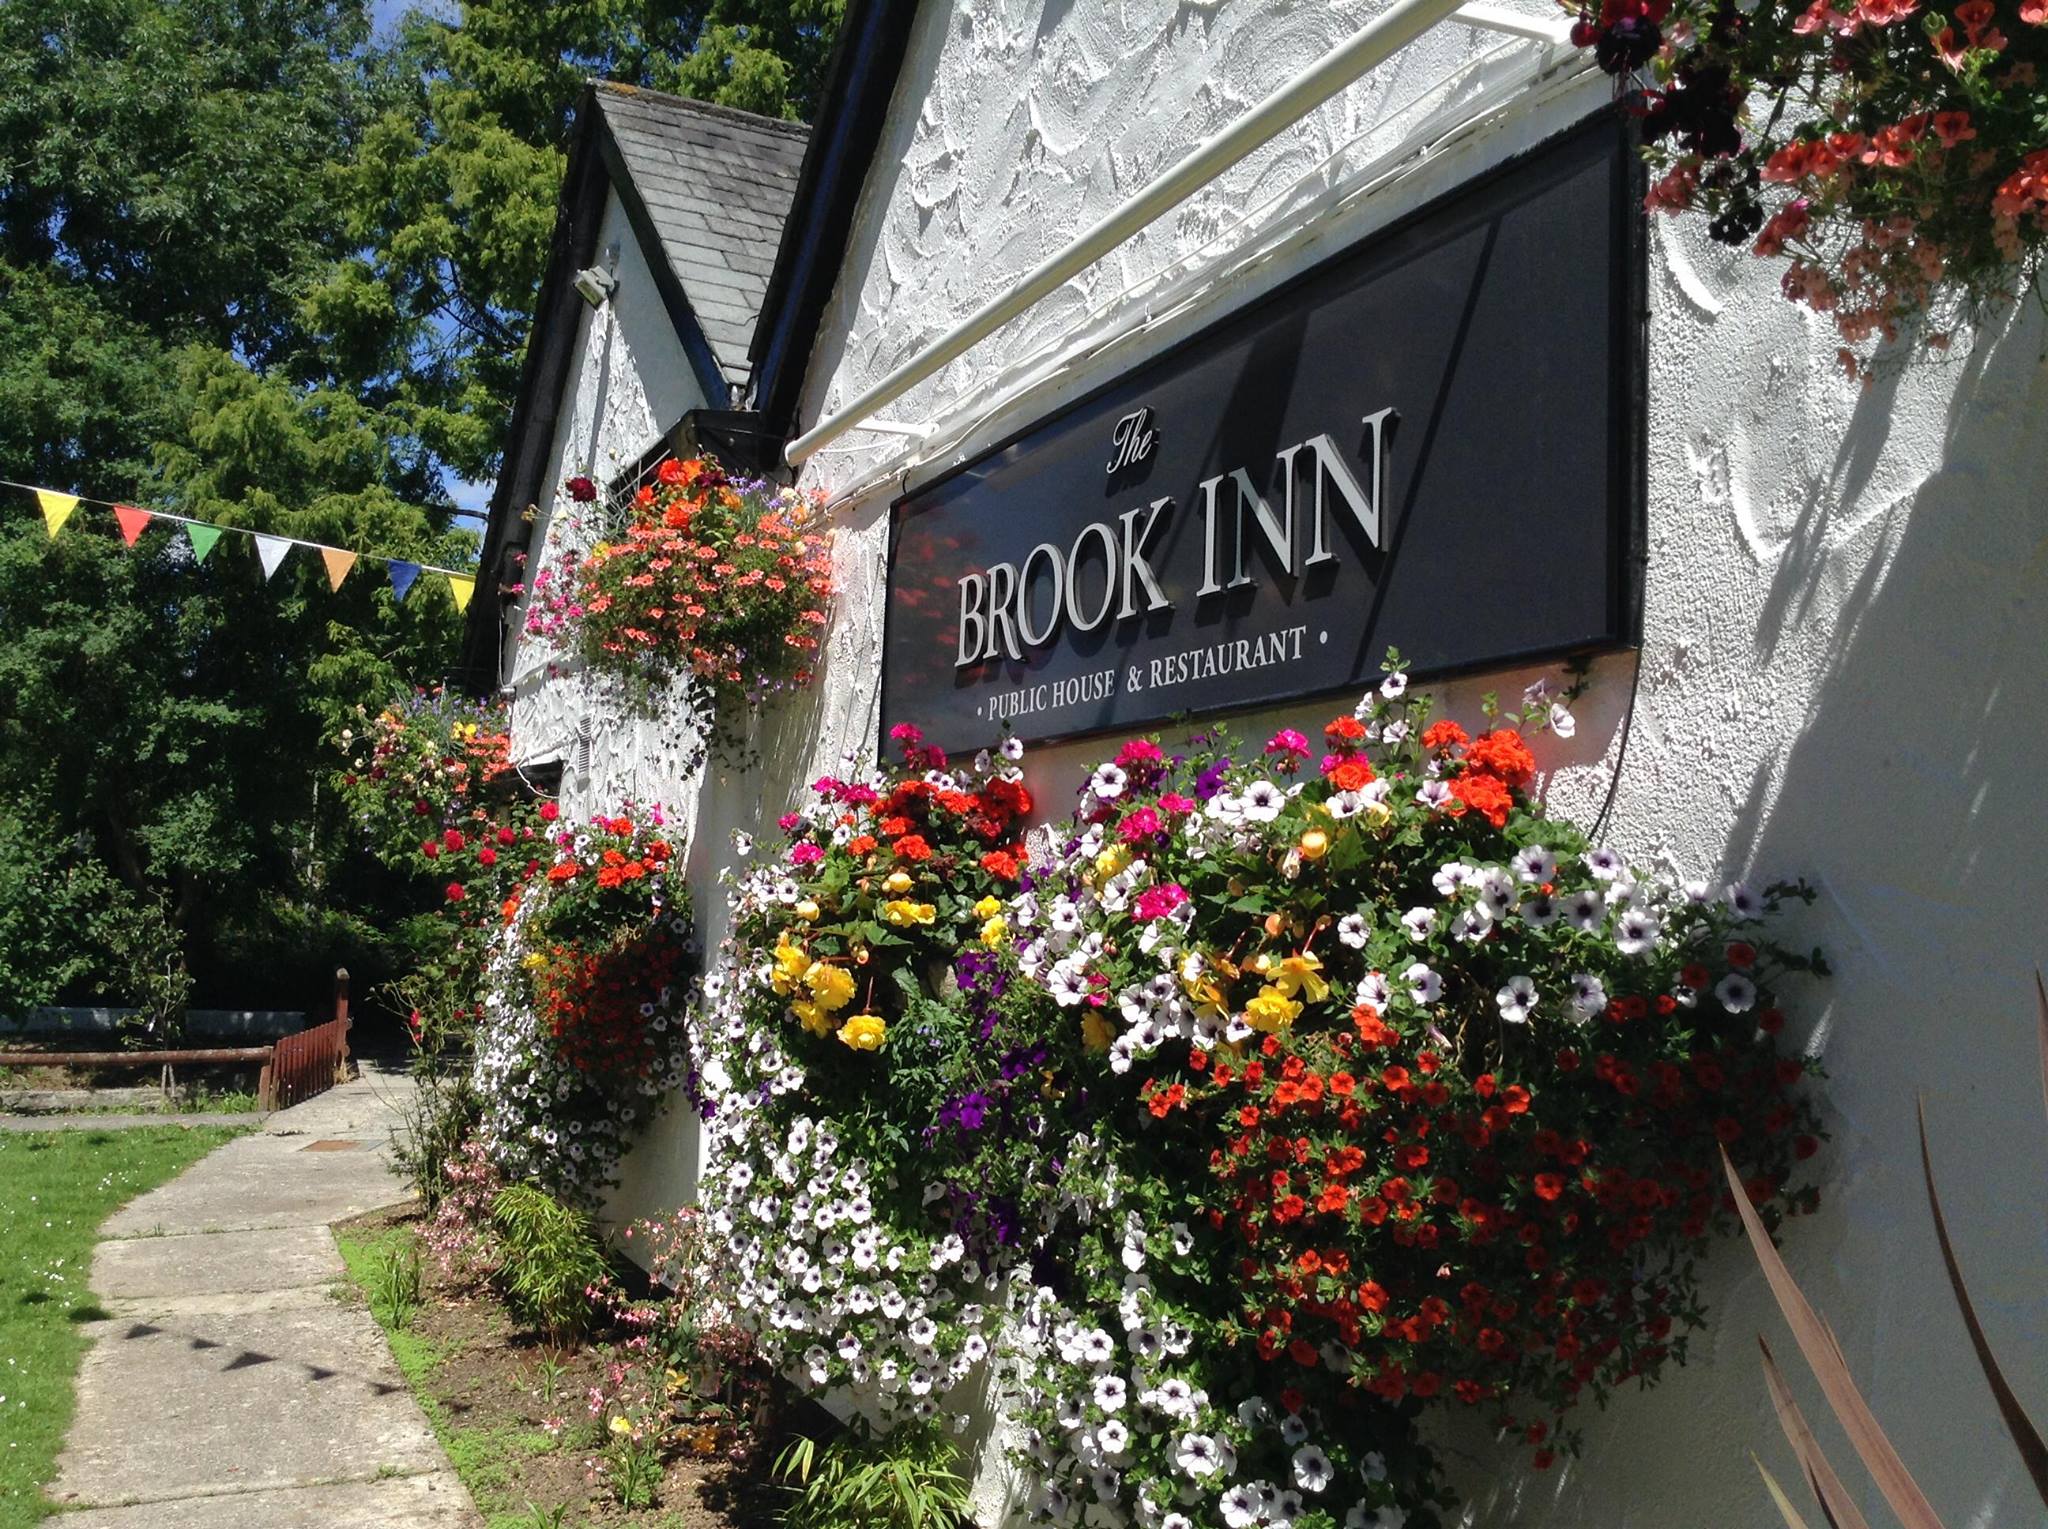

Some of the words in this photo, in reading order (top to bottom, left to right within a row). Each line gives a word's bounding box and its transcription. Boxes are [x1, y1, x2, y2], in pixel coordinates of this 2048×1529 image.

[1106, 405, 1156, 474] The
[954, 494, 1174, 668] BROOK
[1196, 406, 1398, 598] INN
[987, 684, 1048, 722] PUBLIC
[1052, 669, 1115, 711] HOUSE
[1126, 665, 1144, 694] &
[1149, 625, 1307, 689] RESTAURANT
